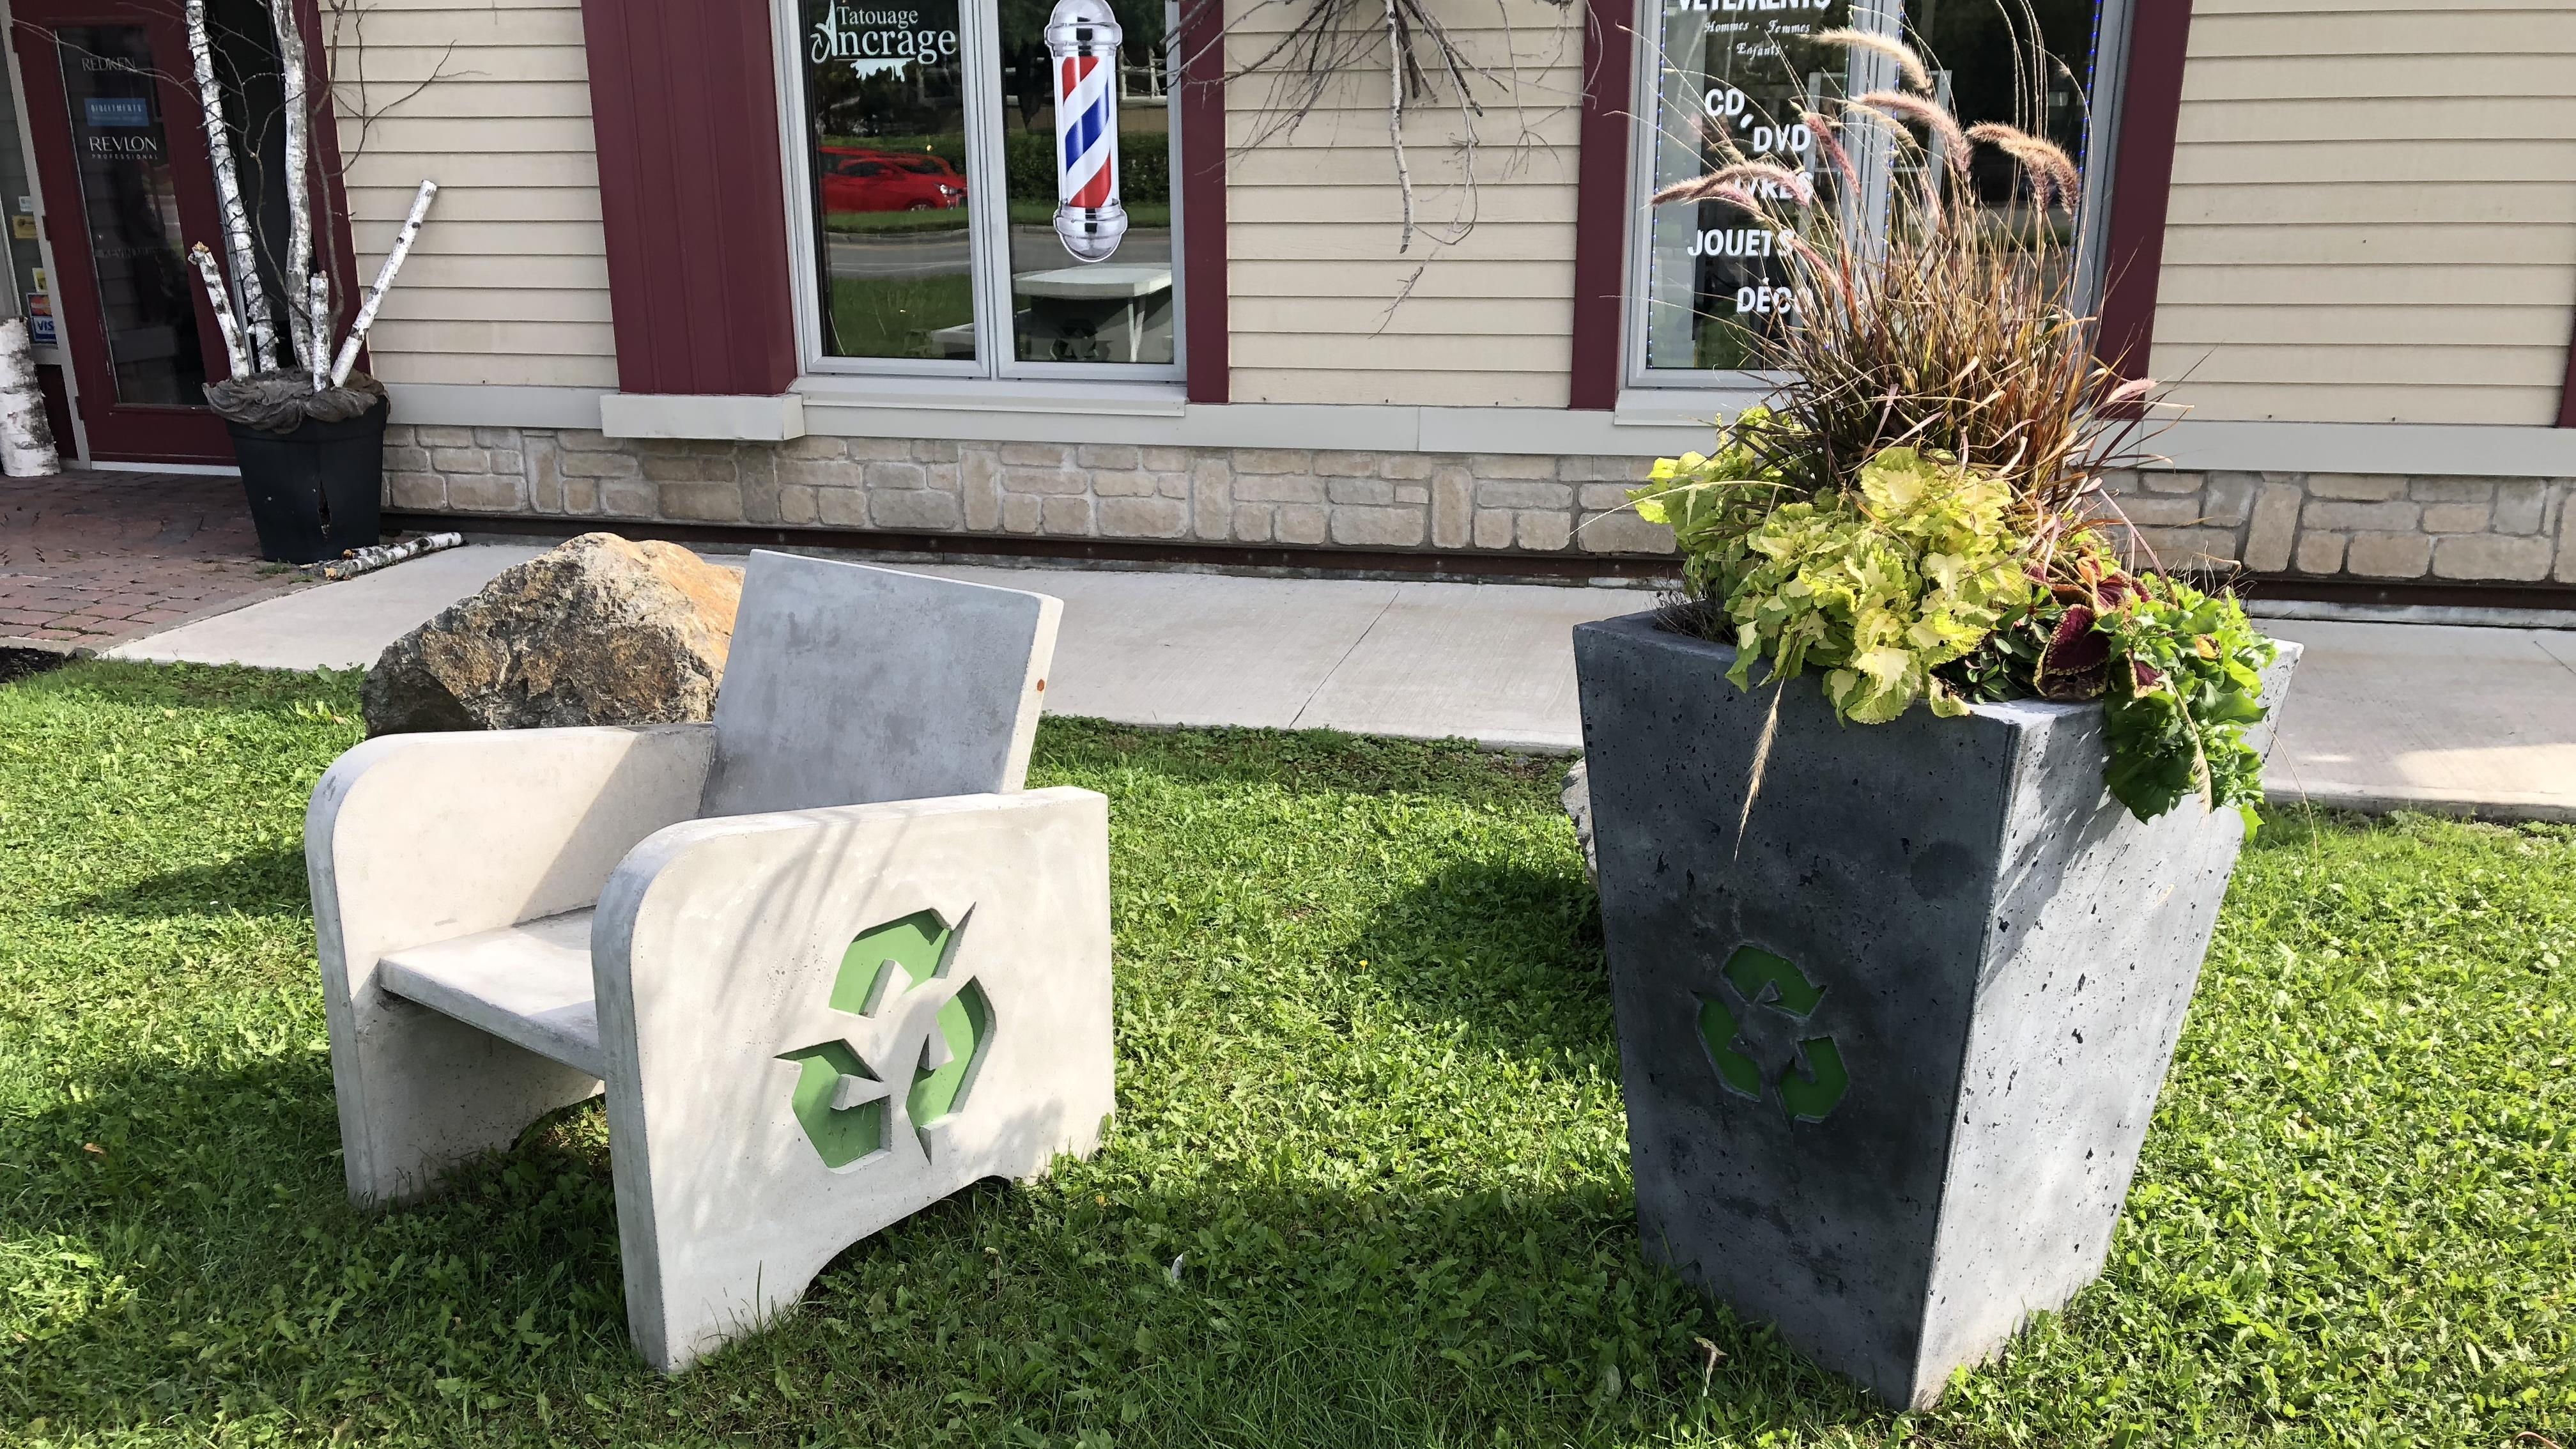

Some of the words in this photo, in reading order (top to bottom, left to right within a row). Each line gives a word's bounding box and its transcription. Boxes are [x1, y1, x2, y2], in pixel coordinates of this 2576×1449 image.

[837, 6, 918, 29] Tatouage
[1704, 20, 1750, 33] Hommes
[1767, 19, 1810, 34] Femmes
[810, 0, 957, 64] Ancrage
[1736, 41, 1782, 61] Enfants
[81, 56, 136, 72] REDKEN
[89, 135, 157, 152] REVLON
[1754, 123, 1812, 153] DVD
[1687, 228, 1794, 257] JOUETS
[37, 320, 55, 331] VIS
